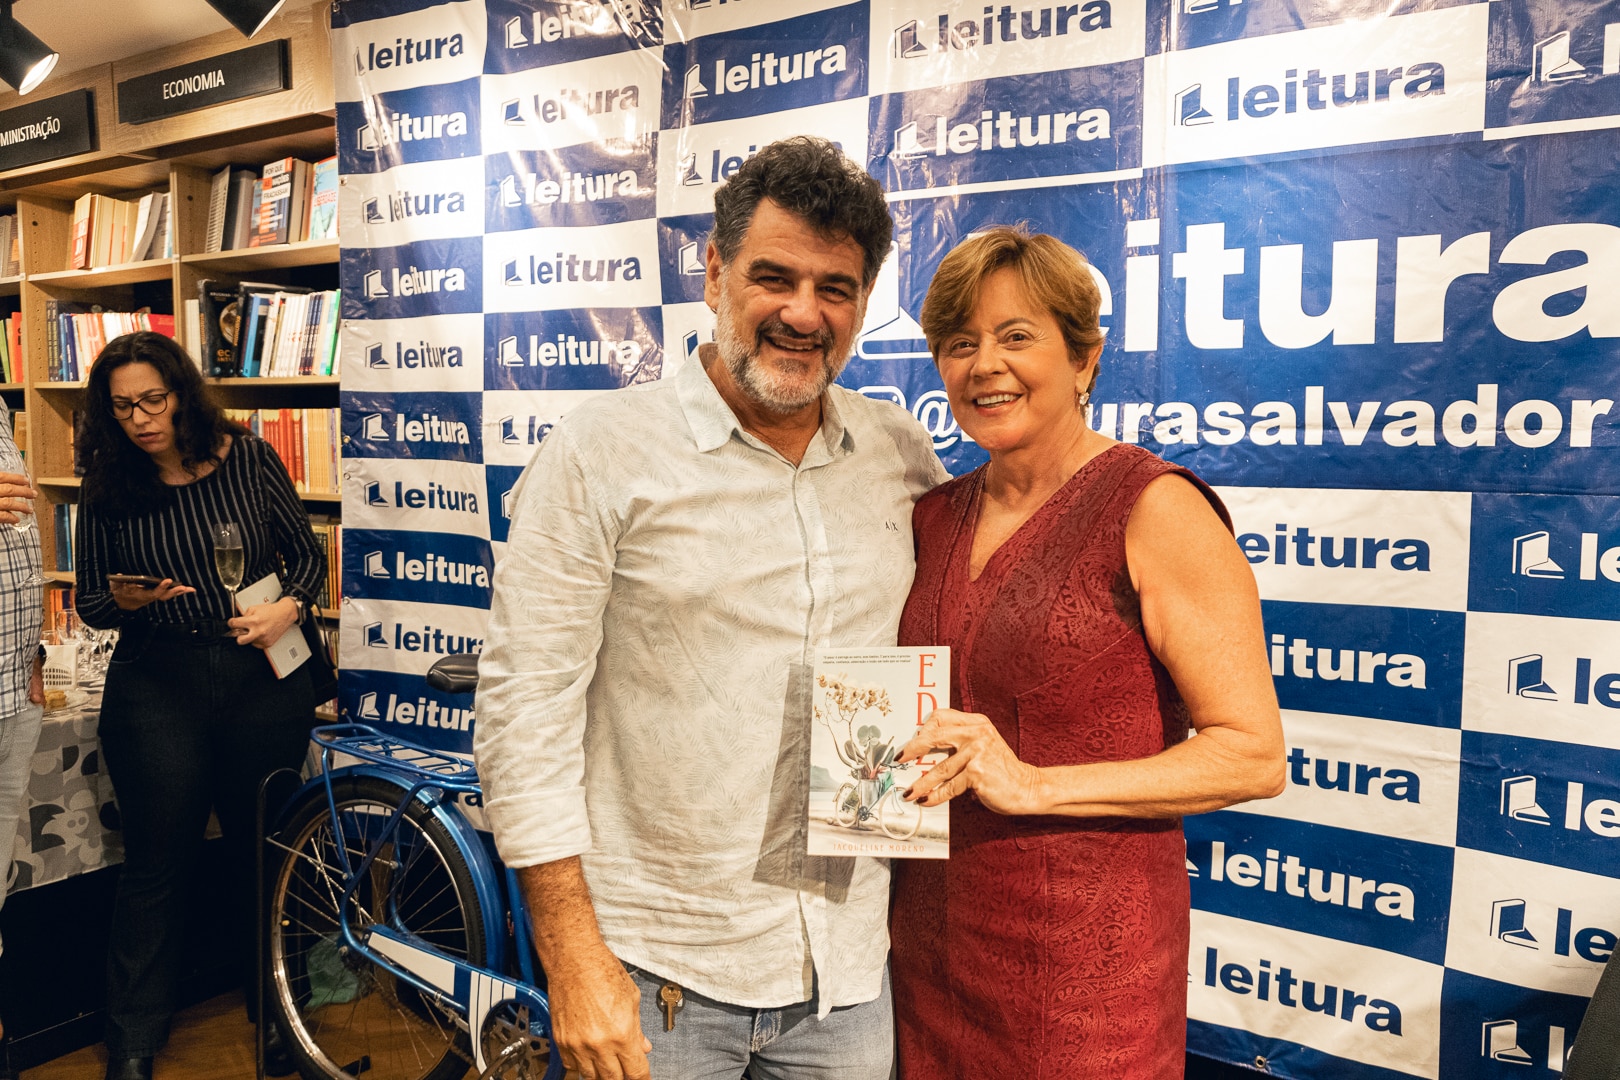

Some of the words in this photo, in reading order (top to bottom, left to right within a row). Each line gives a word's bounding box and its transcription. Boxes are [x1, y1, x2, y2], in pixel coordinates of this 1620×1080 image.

[938, 0, 1112, 53] leitura
[368, 32, 464, 71] leitura
[715, 44, 847, 95] leitura
[163, 69, 225, 99] ECONOMIA
[1227, 61, 1446, 121] leitura
[0, 116, 61, 147] MINISTRAÇÃO
[381, 111, 468, 147] eitura
[935, 107, 1111, 157] leitura
[524, 169, 638, 205] leitura
[388, 191, 466, 223] leitura
[391, 267, 466, 297] leitura
[529, 252, 642, 285] leitura
[1084, 218, 1620, 353] itura
[396, 340, 464, 370] leitura
[529, 333, 640, 367] leitura
[396, 413, 470, 445] leitura
[394, 481, 479, 515] leitura
[1235, 523, 1431, 572] eitura
[396, 551, 490, 588] leitura
[394, 623, 484, 655] leitur
[1271, 633, 1427, 690] itura
[386, 693, 476, 731] leitur
[1286, 747, 1421, 804] tura
[889, 843, 926, 853] MORENO
[1210, 840, 1415, 921] leitura
[1204, 946, 1403, 1037] leitura
